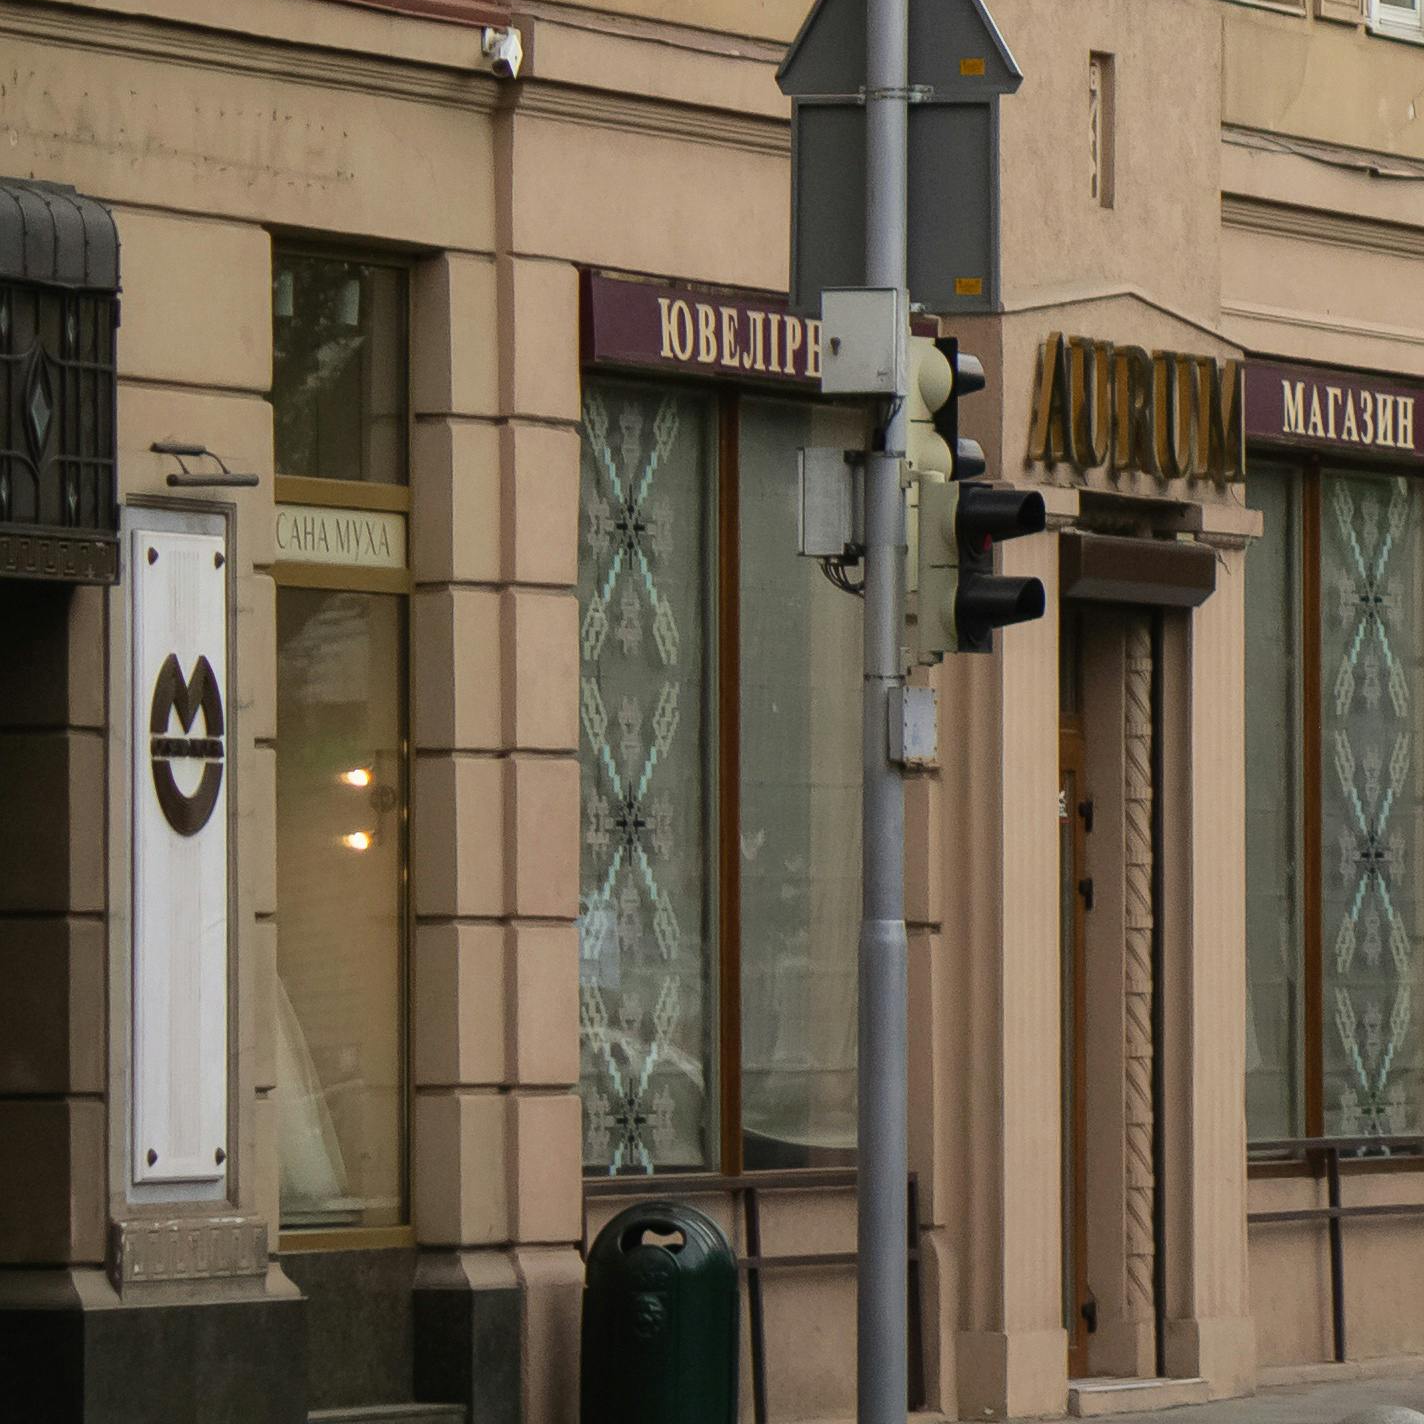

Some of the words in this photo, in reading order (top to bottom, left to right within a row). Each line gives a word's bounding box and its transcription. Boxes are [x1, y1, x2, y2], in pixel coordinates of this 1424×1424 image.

[1029, 331, 1246, 483] AURUM
[1281, 379, 1416, 450] МАГАЗИН
[335, 518, 391, 562] МУХА
